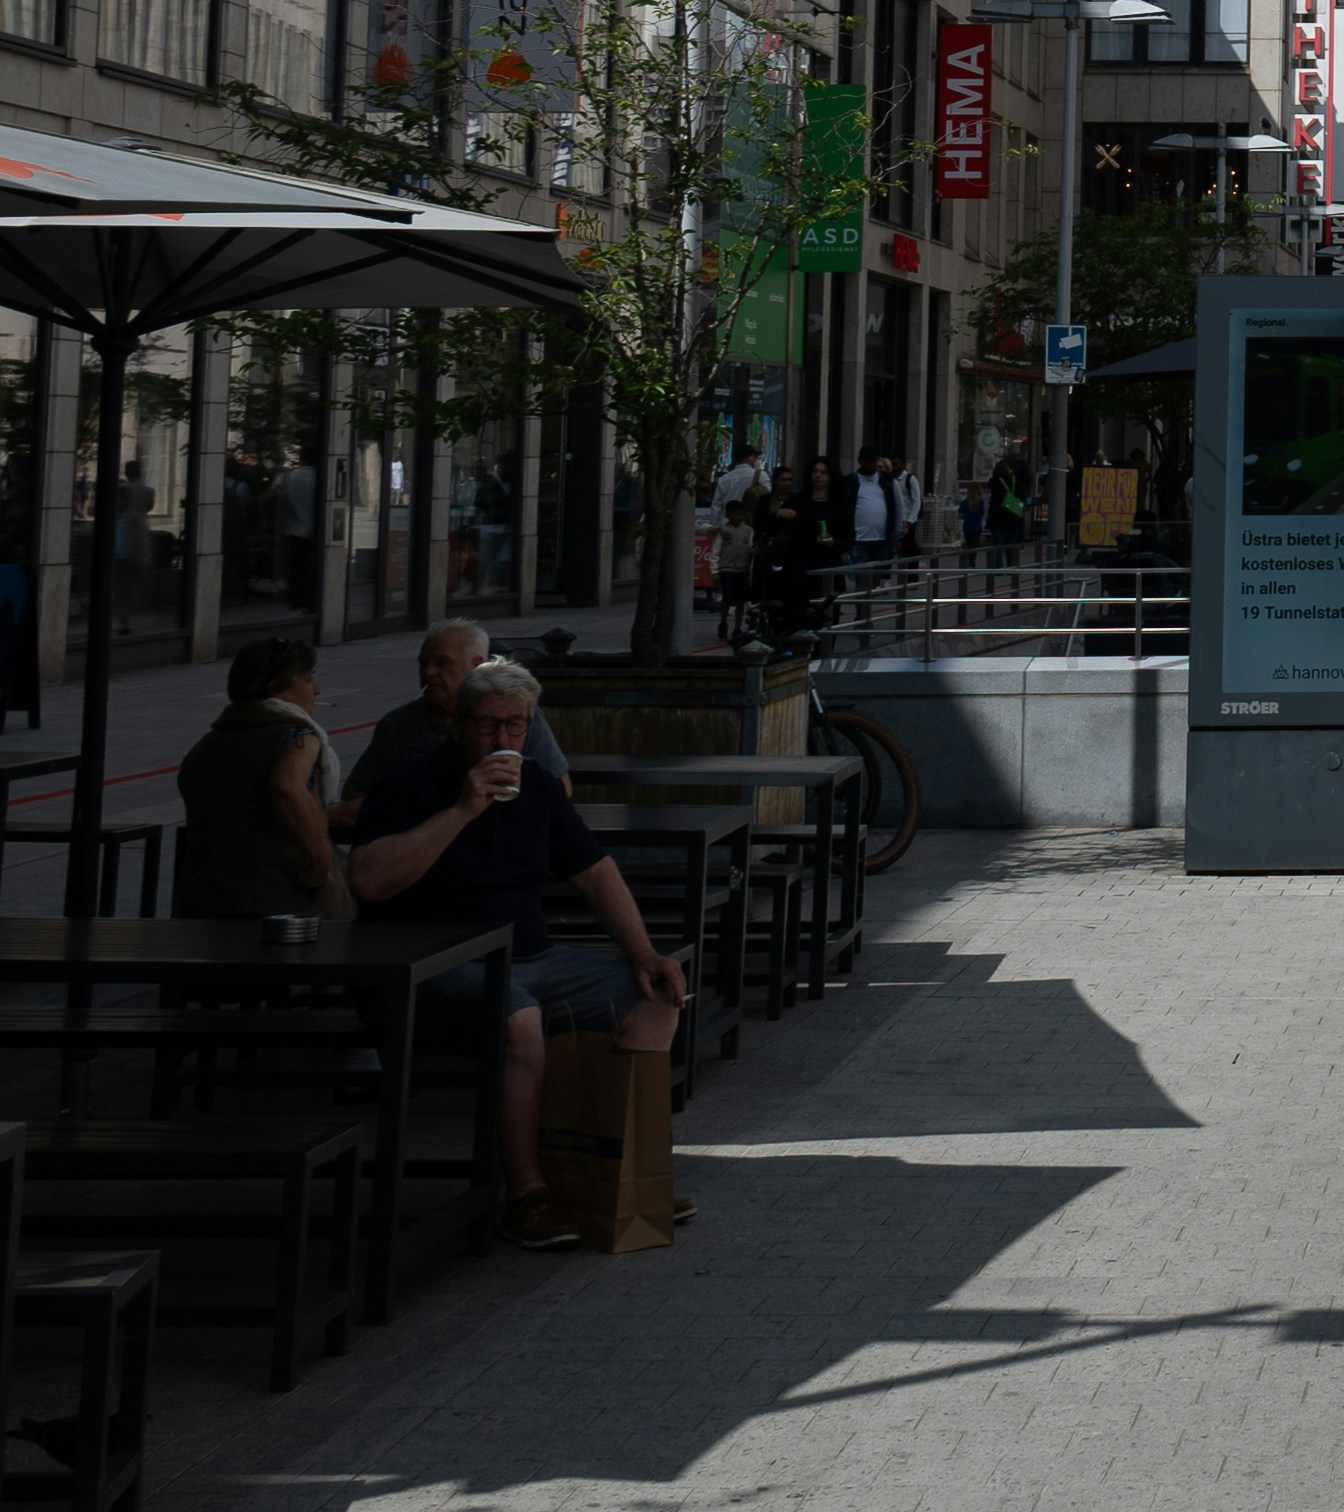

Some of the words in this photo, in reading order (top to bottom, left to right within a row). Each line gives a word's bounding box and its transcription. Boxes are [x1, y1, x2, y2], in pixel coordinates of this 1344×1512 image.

[944, 44, 985, 179] HEMA
[802, 228, 859, 244] ASD
[1246, 318, 1289, 329] Regional.
[1242, 530, 1282, 546] Üstra
[1287, 533, 1331, 546] bietet
[1241, 557, 1334, 570] kostenloses
[1241, 582, 1254, 594] in
[1259, 581, 1296, 594] allen
[1241, 606, 1260, 619] 19
[1221, 700, 1279, 715] STRÖER
